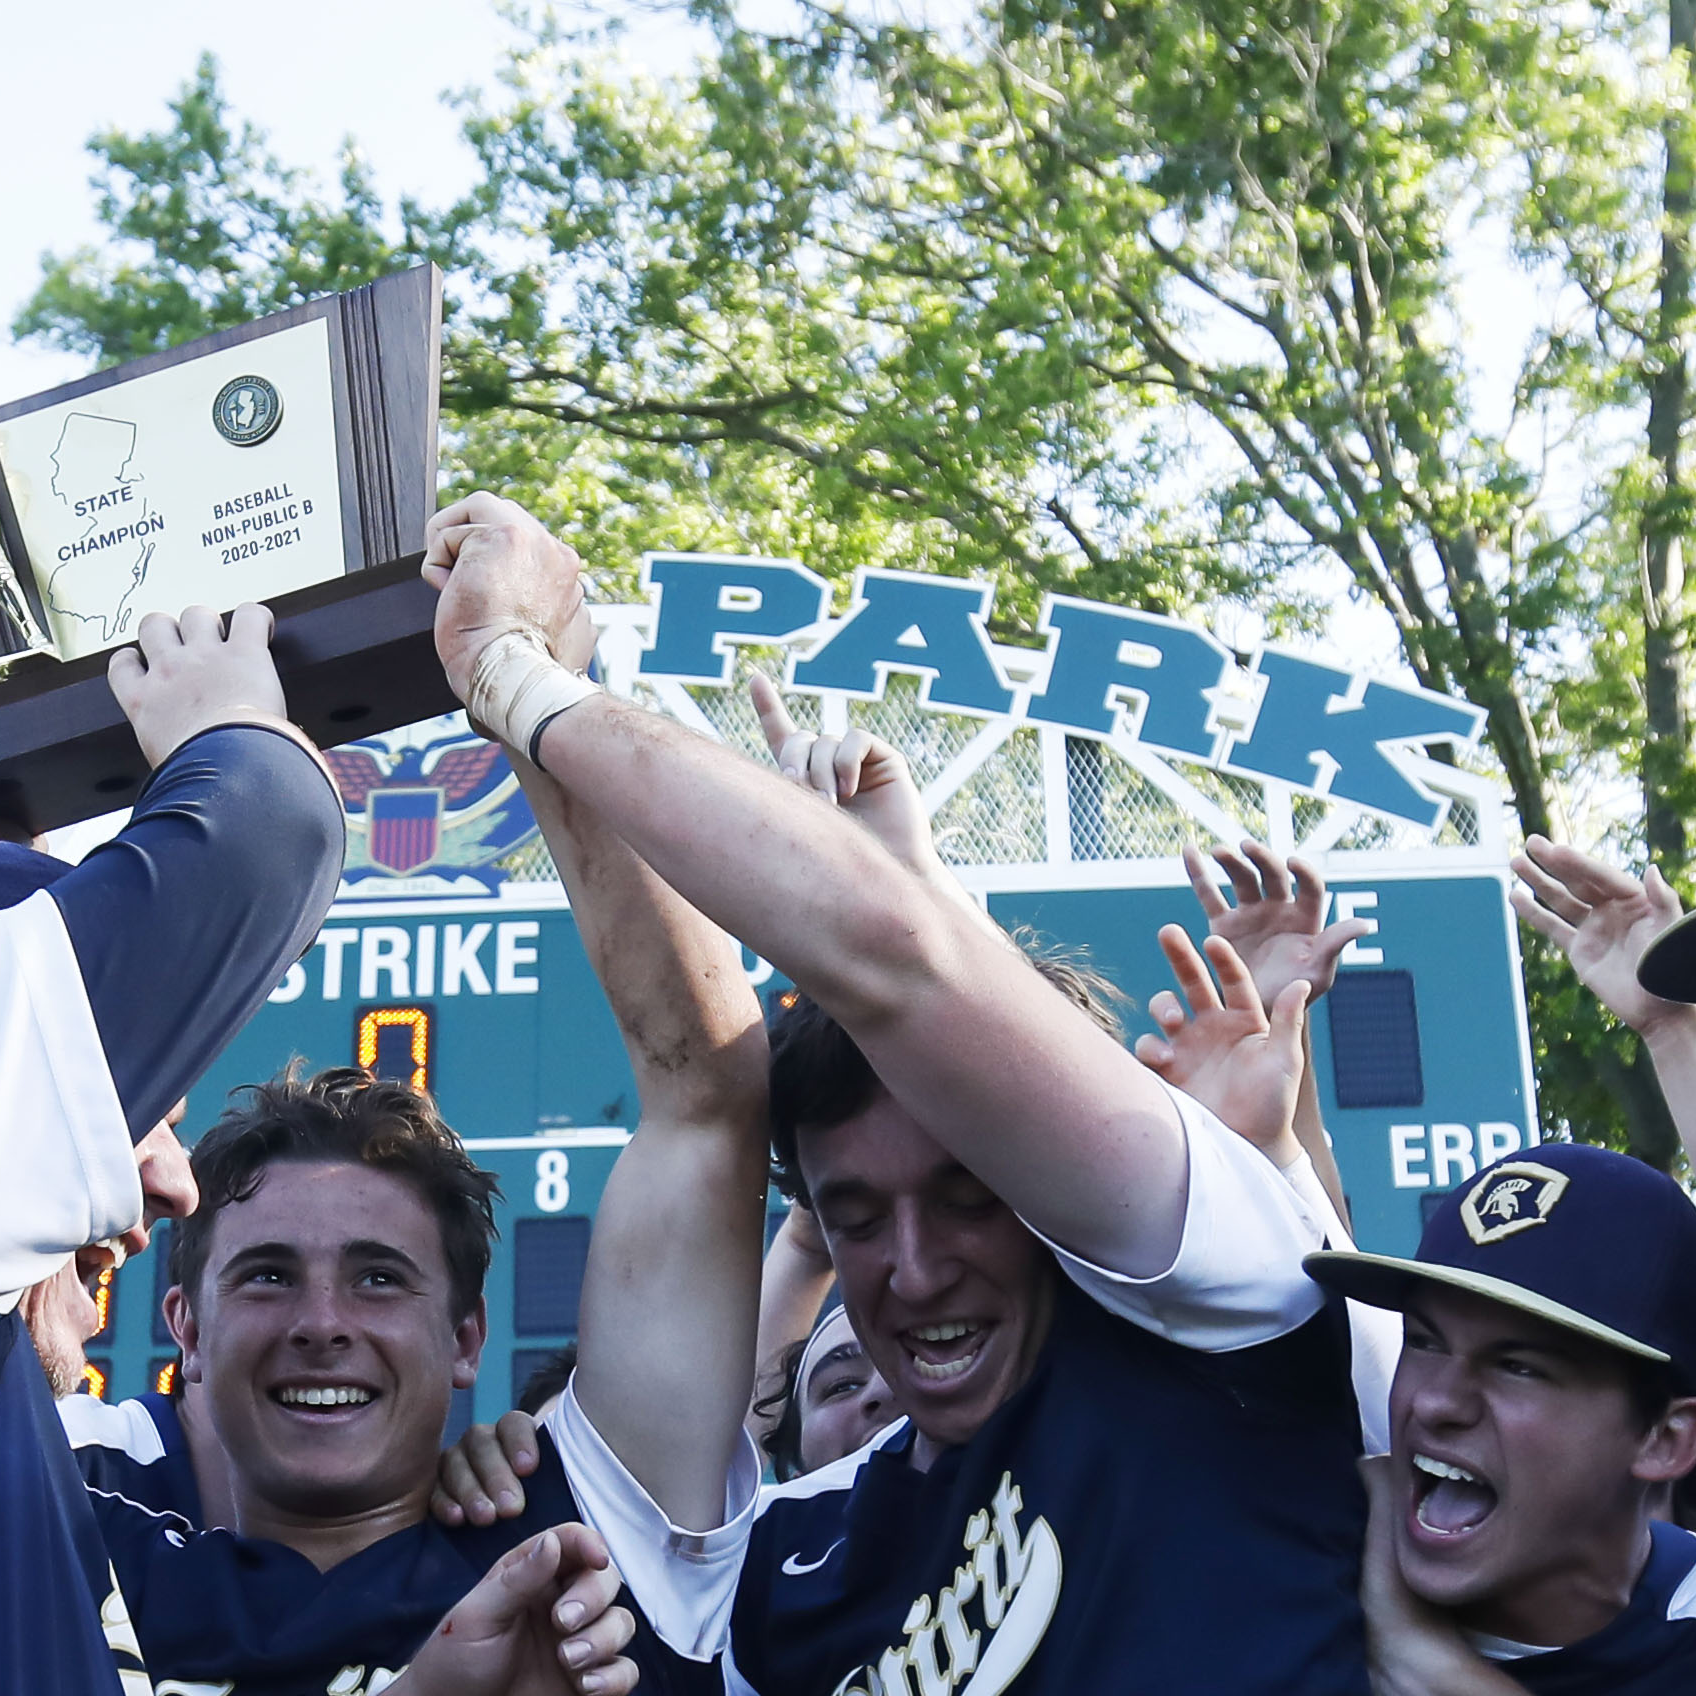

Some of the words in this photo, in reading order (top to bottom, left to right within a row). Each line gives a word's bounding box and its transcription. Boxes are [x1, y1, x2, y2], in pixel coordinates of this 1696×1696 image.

[74, 486, 134, 517] STATE
[201, 503, 299, 547] NON-PUBLIC
[303, 499, 314, 515] B
[213, 483, 294, 520] BASEBALL
[58, 514, 165, 562] CHAMPION
[221, 527, 302, 565] 2020-2021
[639, 558, 1486, 830] PARK
[534, 1149, 570, 1213] 8
